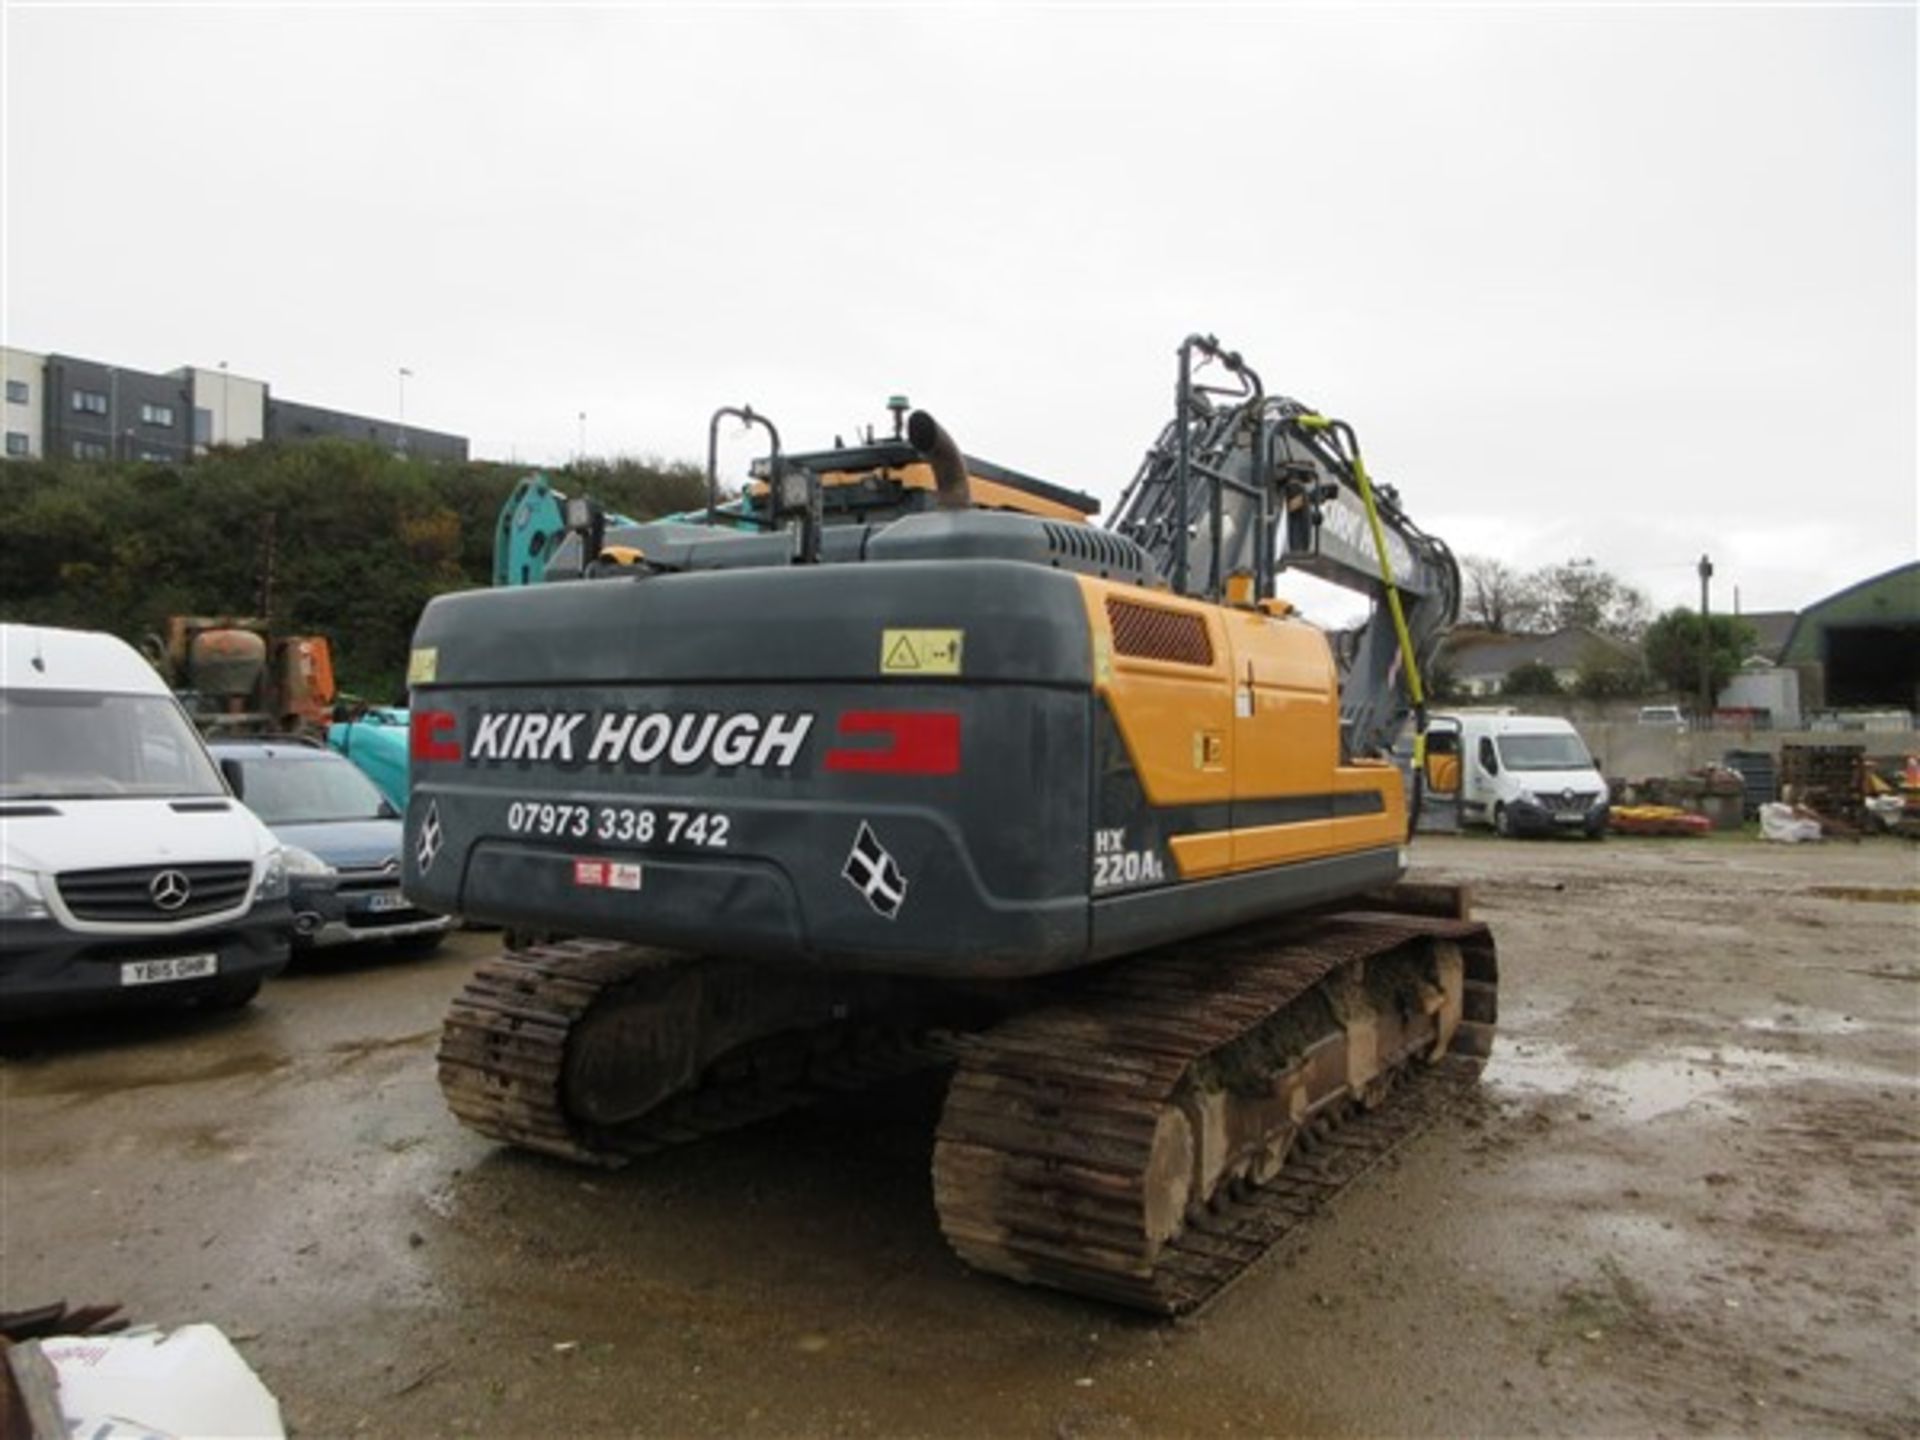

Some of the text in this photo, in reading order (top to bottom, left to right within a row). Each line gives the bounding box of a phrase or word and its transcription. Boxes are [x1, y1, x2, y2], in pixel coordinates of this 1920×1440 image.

[470, 712, 814, 766] KIRK HOUGH
[508, 802, 731, 847] 07973 338 742
[1095, 827, 1125, 853] HX
